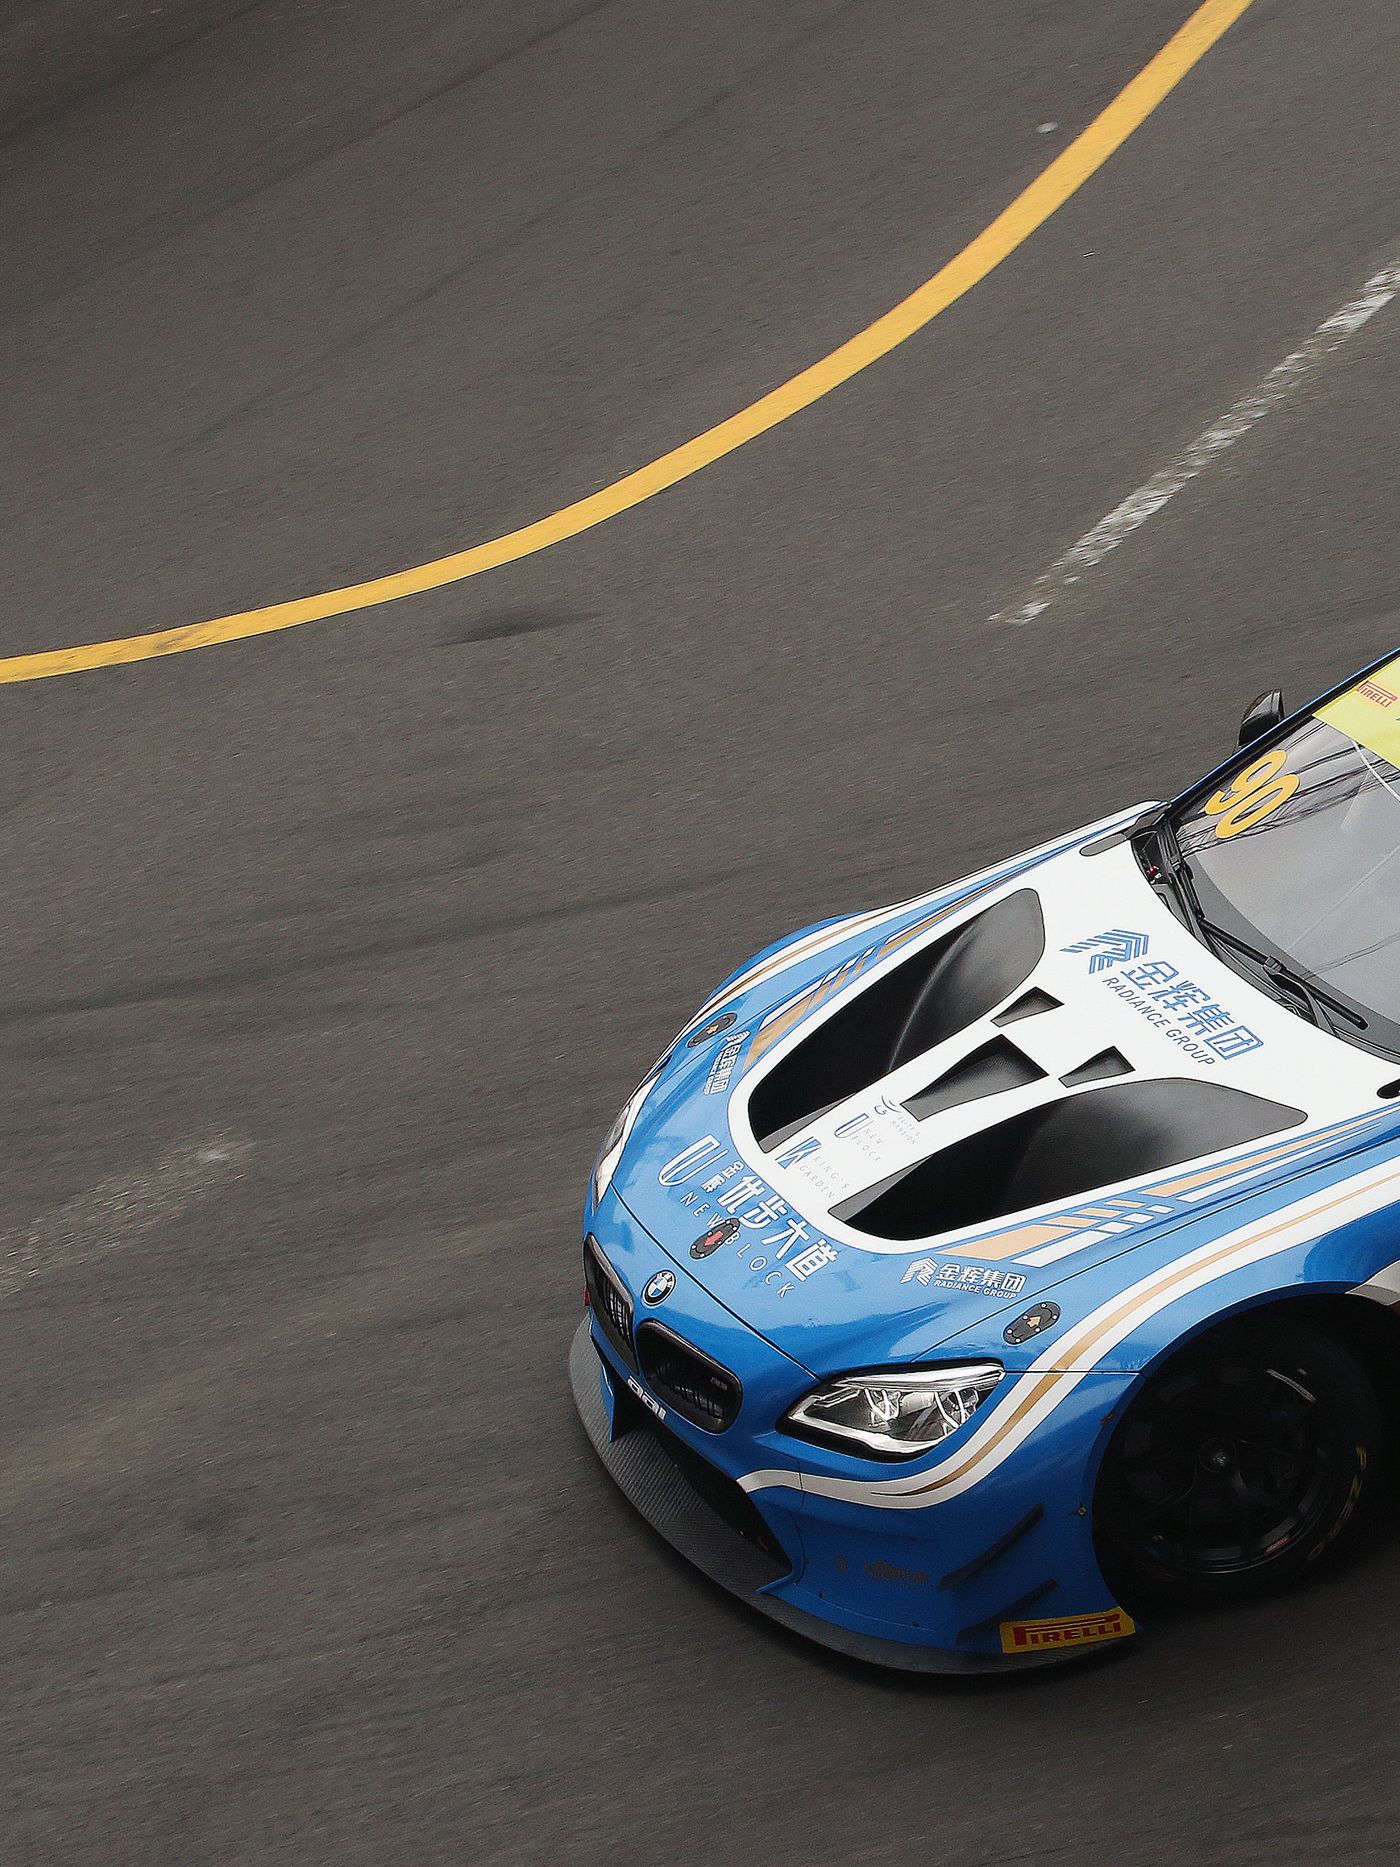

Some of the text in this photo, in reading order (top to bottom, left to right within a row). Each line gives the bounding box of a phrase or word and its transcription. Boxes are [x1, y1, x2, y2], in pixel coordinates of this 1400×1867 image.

[1356, 680, 1399, 709] PIRELLI
[1204, 749, 1300, 839] 90
[1102, 976, 1216, 1066] RADIANCE GROUP
[1119, 960, 1265, 1061] 金辉集团
[799, 1164, 836, 1199] GARDEN
[680, 1190, 795, 1298] NEW BLOCK
[717, 1175, 839, 1282] 优步大道
[933, 1279, 1018, 1299] RADIANCE GROUP
[935, 1263, 1028, 1293] 金辉集团
[1012, 1613, 1121, 1646] PIRELLI
